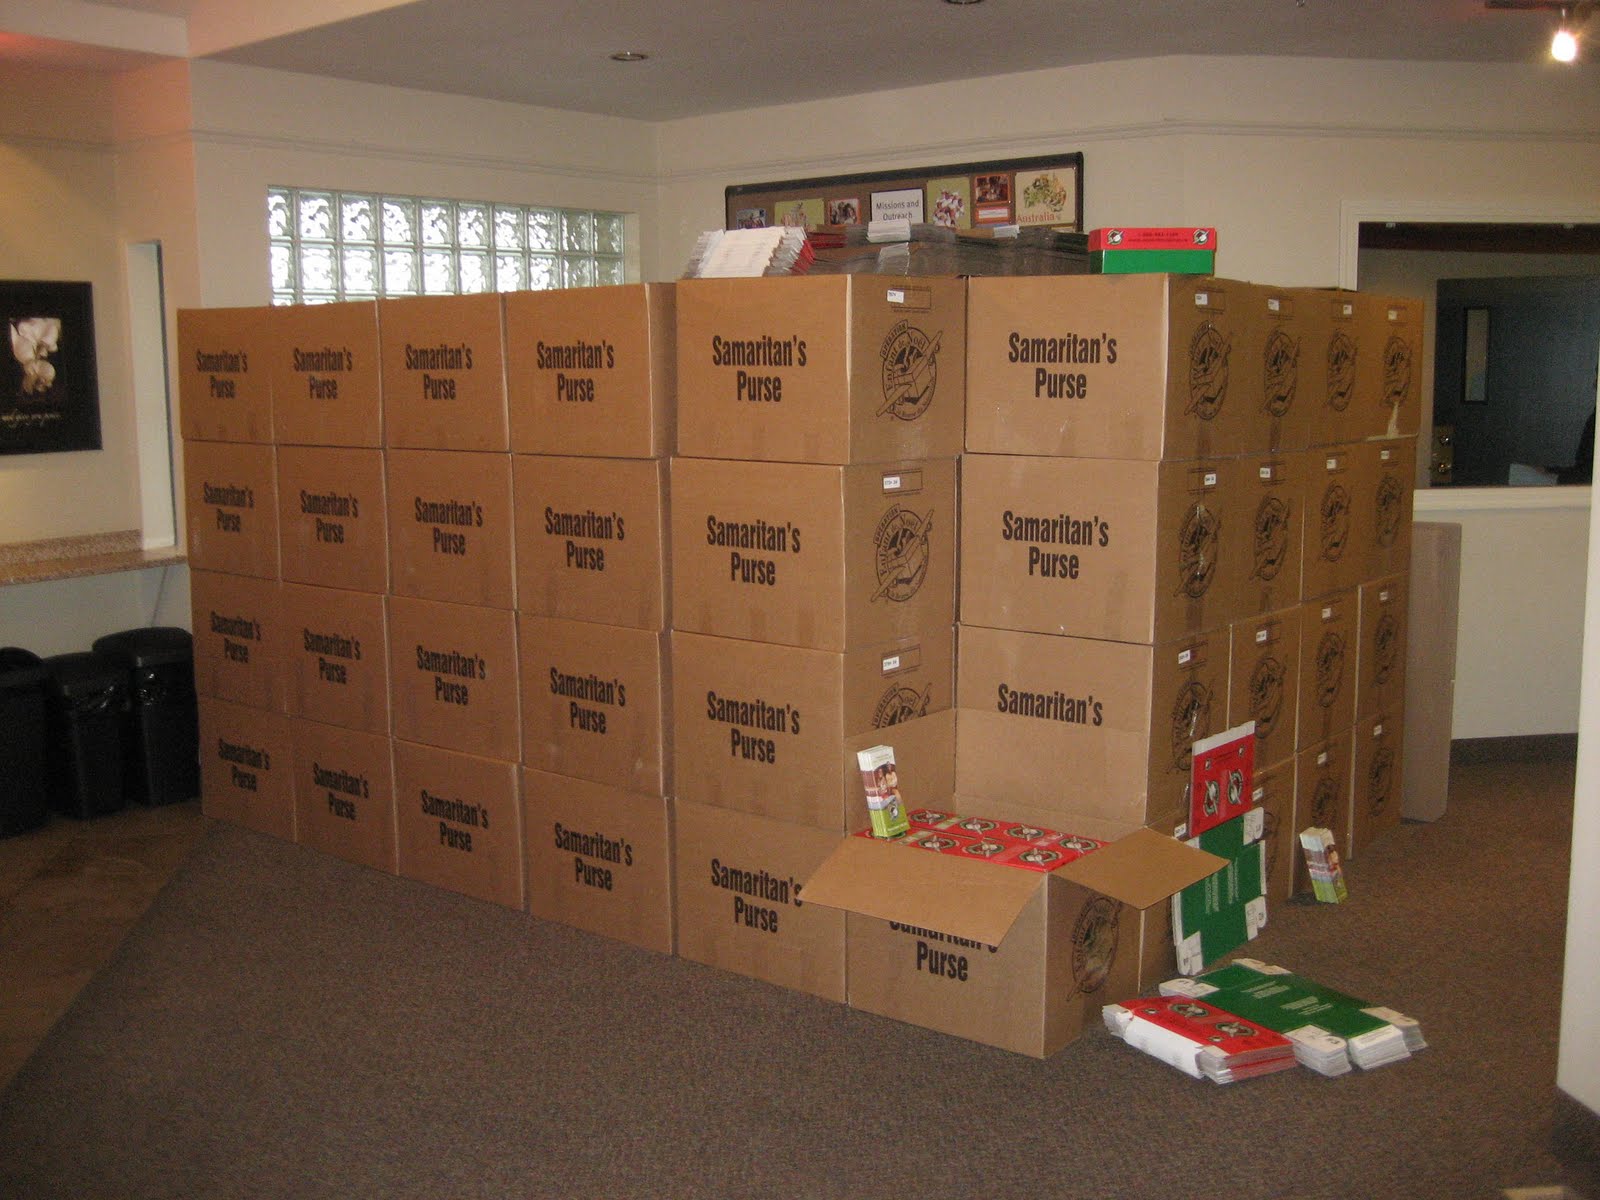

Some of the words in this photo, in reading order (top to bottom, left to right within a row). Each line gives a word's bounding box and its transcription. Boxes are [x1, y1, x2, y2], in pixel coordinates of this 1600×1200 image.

[876, 201, 905, 210] Missions
[907, 200, 919, 208] and
[883, 212, 912, 221] Outreach
[1017, 212, 1055, 223] Australia
[293, 347, 352, 372] Samaritan's
[405, 343, 472, 370] Samaritan's
[537, 340, 614, 370] Samaritan's
[712, 335, 807, 367] Samaritan's
[1008, 332, 1117, 364] Samaritan's
[309, 376, 338, 400] Purse
[423, 374, 456, 400] Purse
[557, 374, 594, 402] Purse
[737, 371, 782, 402] Purse
[1035, 368, 1087, 399] Purse
[415, 496, 483, 528] Samaritan's
[544, 507, 625, 541] Samaritan's
[316, 517, 344, 544] Purse
[433, 527, 466, 556] Purse
[707, 515, 800, 553] Samaritan's
[1002, 510, 1109, 547] Samaritan's
[566, 540, 604, 571] Purse
[731, 552, 776, 586] Purse
[1029, 547, 1079, 579] Purse
[416, 645, 485, 680] Samaritan's
[435, 676, 468, 706] Purse
[550, 667, 625, 707] Samaritan's
[570, 701, 606, 734] Purse
[707, 691, 800, 735] Samaritan's
[998, 683, 1103, 728] Samaritan's
[731, 728, 775, 764] Purse
[420, 790, 489, 830] Samaritan's
[440, 822, 473, 852] Purse
[554, 822, 633, 866] Samaritan's
[575, 857, 613, 891] Purse
[711, 858, 803, 907] Samaritan's
[734, 896, 778, 934] Purse
[917, 941, 968, 982] Purse
